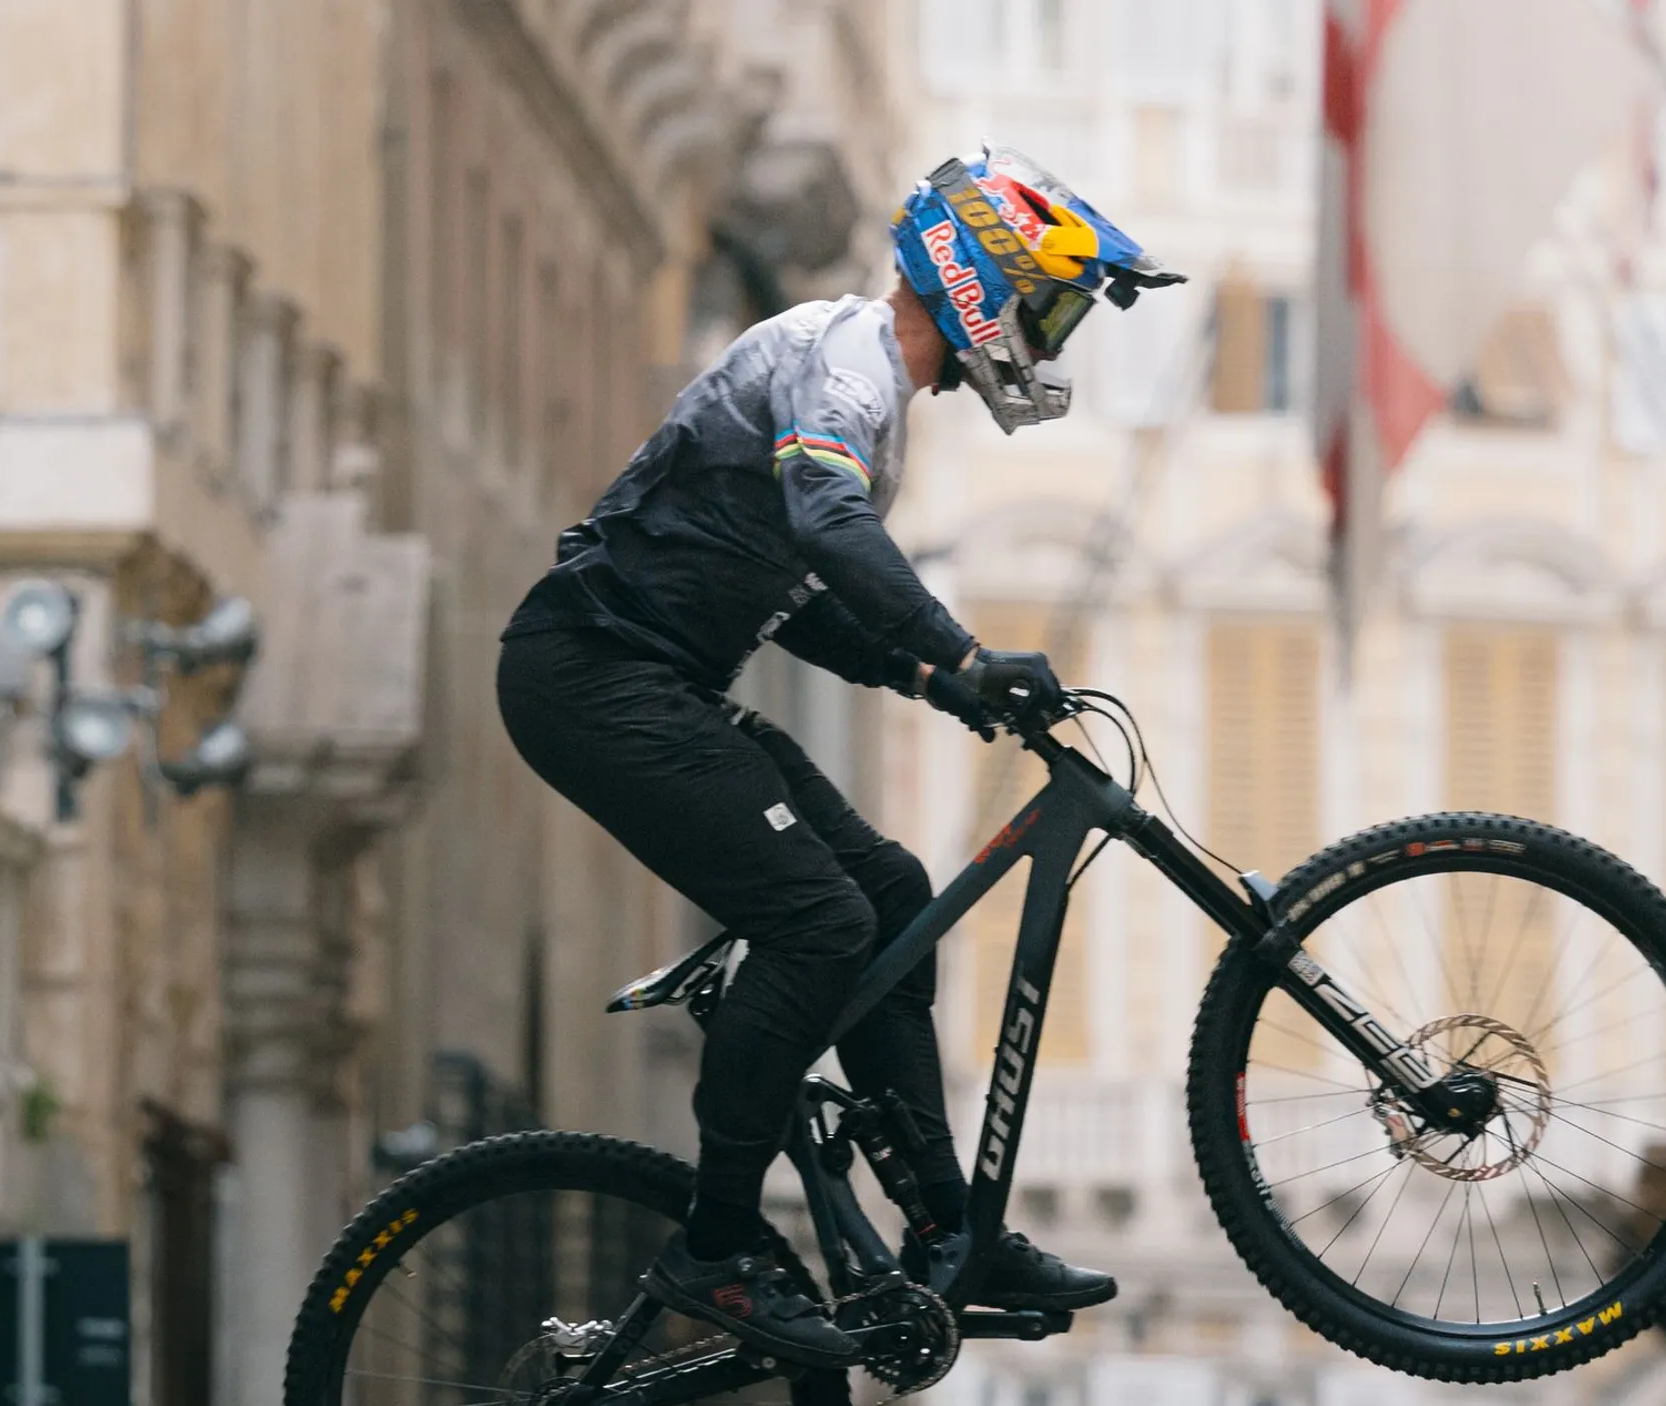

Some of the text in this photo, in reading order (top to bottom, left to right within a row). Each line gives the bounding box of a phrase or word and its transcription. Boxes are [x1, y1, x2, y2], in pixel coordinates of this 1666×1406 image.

[923, 221, 1004, 347] Red Bull
[329, 1208, 419, 1313] MAXXIS
[1493, 1301, 1622, 1356] MAXXIS
